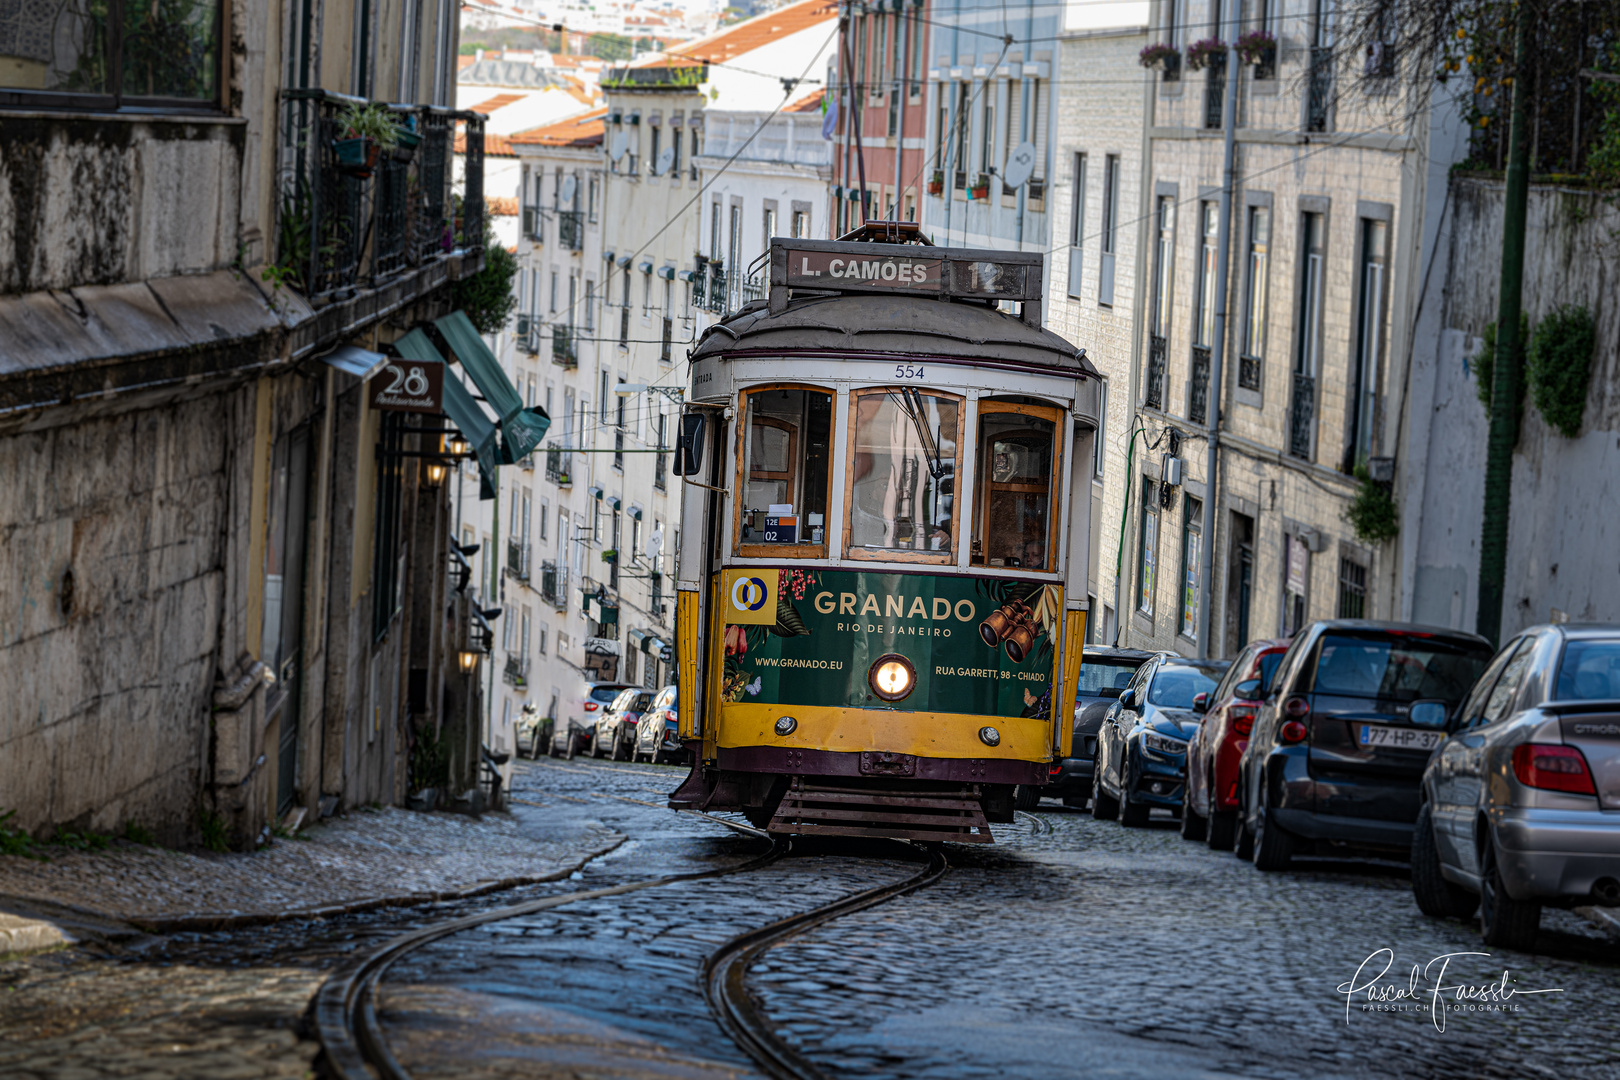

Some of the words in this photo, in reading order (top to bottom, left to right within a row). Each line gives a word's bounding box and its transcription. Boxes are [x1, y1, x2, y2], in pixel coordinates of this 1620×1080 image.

[801, 257, 821, 277] L.
[968, 262, 1004, 290] 12
[384, 364, 429, 396] 28
[895, 364, 925, 380] 554
[766, 518, 778, 526] 12E
[765, 531, 778, 541] 02
[814, 591, 976, 623] GRANADO
[837, 622, 861, 632] RIO
[867, 624, 884, 634] DE
[890, 625, 952, 638] JANEIRO
[755, 657, 843, 670] WWW.GRANADO.EU
[935, 666, 956, 676] RUA
[957, 667, 999, 680] GARRETT,
[1000, 670, 1011, 679] 98
[1017, 671, 1045, 682] CHIADO
